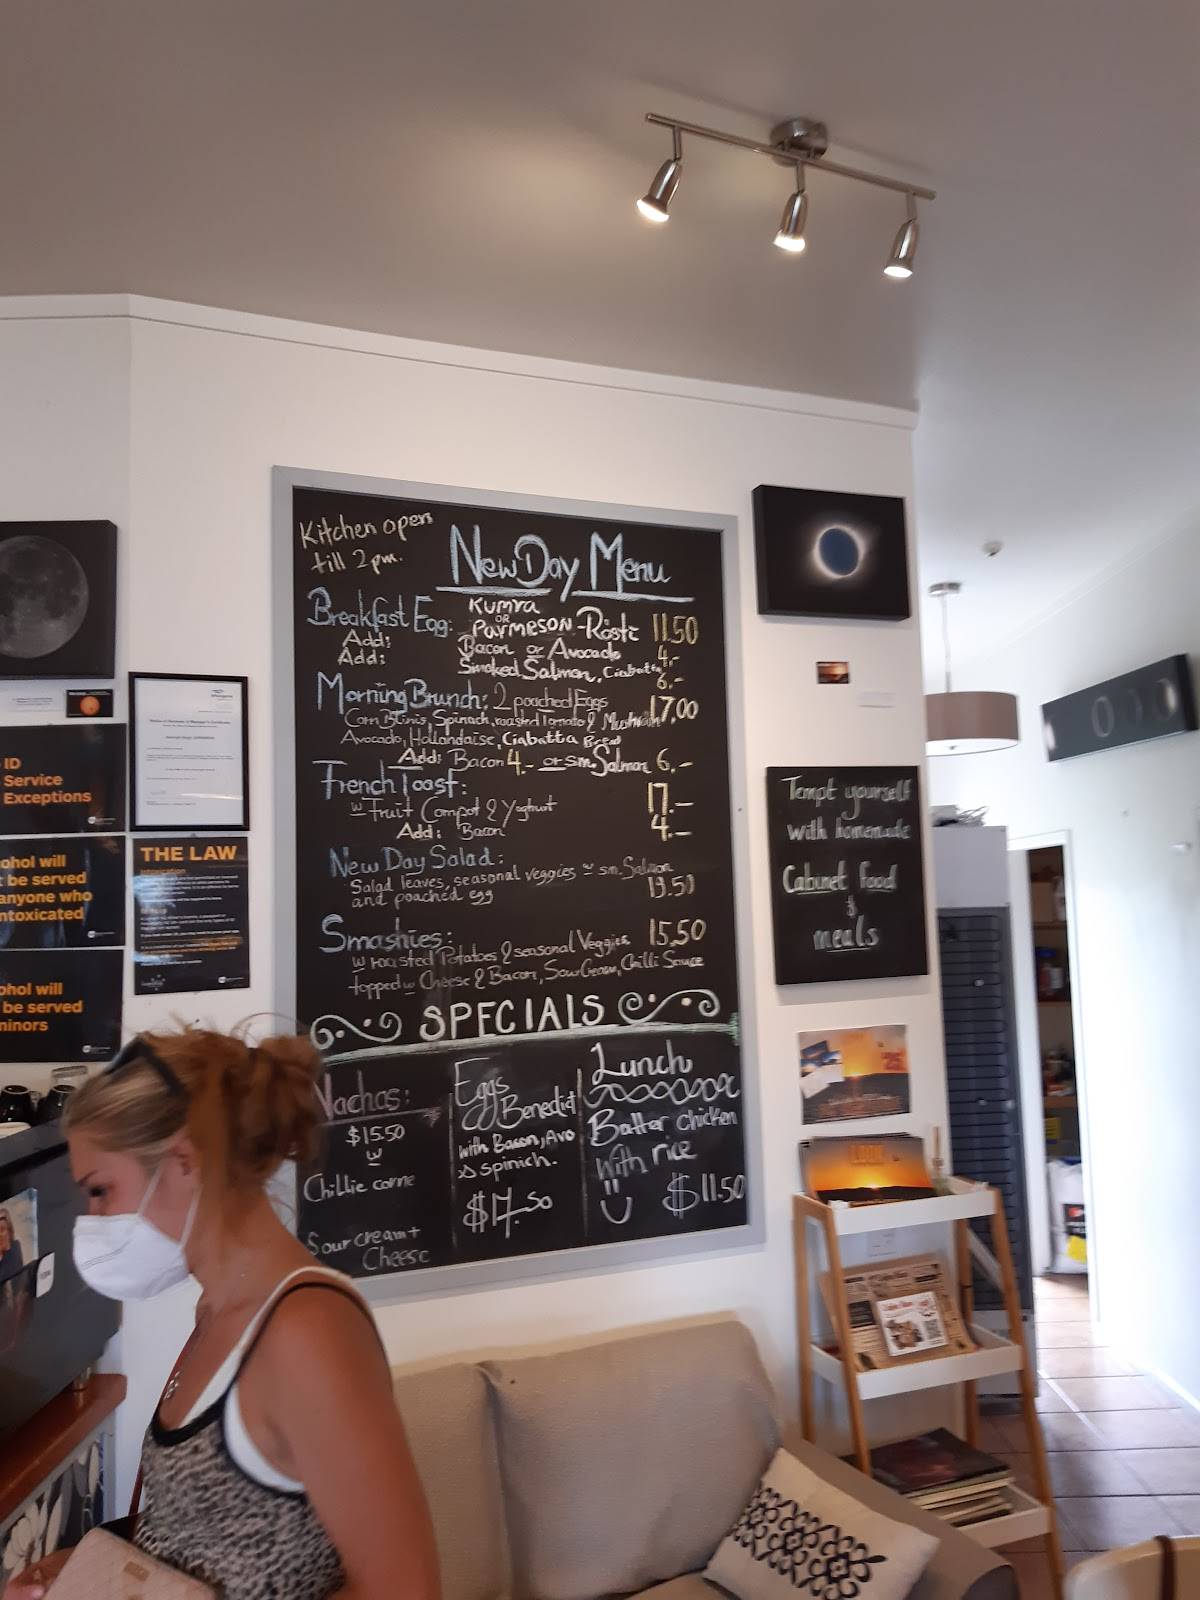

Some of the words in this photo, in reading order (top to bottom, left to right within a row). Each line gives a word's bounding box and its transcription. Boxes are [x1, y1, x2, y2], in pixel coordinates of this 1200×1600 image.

[300, 514, 376, 549] Kitchen
[383, 512, 433, 541] open
[311, 552, 346, 574] till
[451, 524, 517, 584] New
[514, 534, 580, 602] Day
[590, 532, 670, 593] Menu
[307, 586, 410, 632] Breakfast
[414, 596, 453, 638] Egg:
[653, 612, 699, 645] 11.50
[342, 629, 390, 648] Add:
[458, 635, 515, 658] Bacon
[547, 637, 622, 661] Avocado
[338, 647, 385, 665] Add:
[458, 656, 521, 677] Smoked
[317, 672, 408, 716] Morning
[404, 679, 488, 711] Brunch:
[493, 682, 512, 710] 2
[514, 687, 573, 717] poached
[502, 731, 579, 746] Ciabatta
[4, 757, 21, 770] ID
[398, 748, 441, 765] Add:
[447, 748, 504, 771] Bacon
[4, 773, 64, 787] Service
[312, 760, 397, 800] French
[388, 765, 466, 799] Toast:
[3, 790, 93, 806] Exceptions
[362, 797, 413, 822] Fruit
[780, 775, 839, 807] Tempt
[841, 777, 912, 820] yourself
[396, 822, 441, 839] Add:
[459, 823, 506, 841] Bacon
[787, 816, 828, 841] with
[835, 817, 911, 841] homemade
[0, 855, 35, 868] ohol
[39, 854, 66, 868] will
[140, 846, 184, 862] THE
[189, 845, 237, 861] LAW
[330, 847, 379, 878] New
[383, 847, 426, 876] Day
[430, 844, 503, 869] Salad:
[7, 874, 28, 886] be
[32, 871, 87, 885] served
[350, 877, 393, 894] Salad
[59, 889, 93, 902] who
[352, 894, 387, 908] and
[394, 888, 463, 910] poached
[469, 889, 493, 906] egg
[0, 906, 84, 921] ntoxicated
[813, 915, 880, 952] meals
[371, 949, 434, 968] roasted
[514, 930, 577, 958] seasonal
[0, 982, 32, 996] ohol
[36, 982, 63, 995] will
[349, 973, 401, 999] topped
[3, 1000, 24, 1014] be
[27, 999, 83, 1014] served
[419, 994, 605, 1041] SPECIALS
[590, 1039, 693, 1086] Lunch
[454, 1057, 510, 1131] Eggs
[652, 1135, 698, 1166] rice
[304, 1172, 368, 1202] Chillie
[362, 1244, 431, 1272] Cheese
